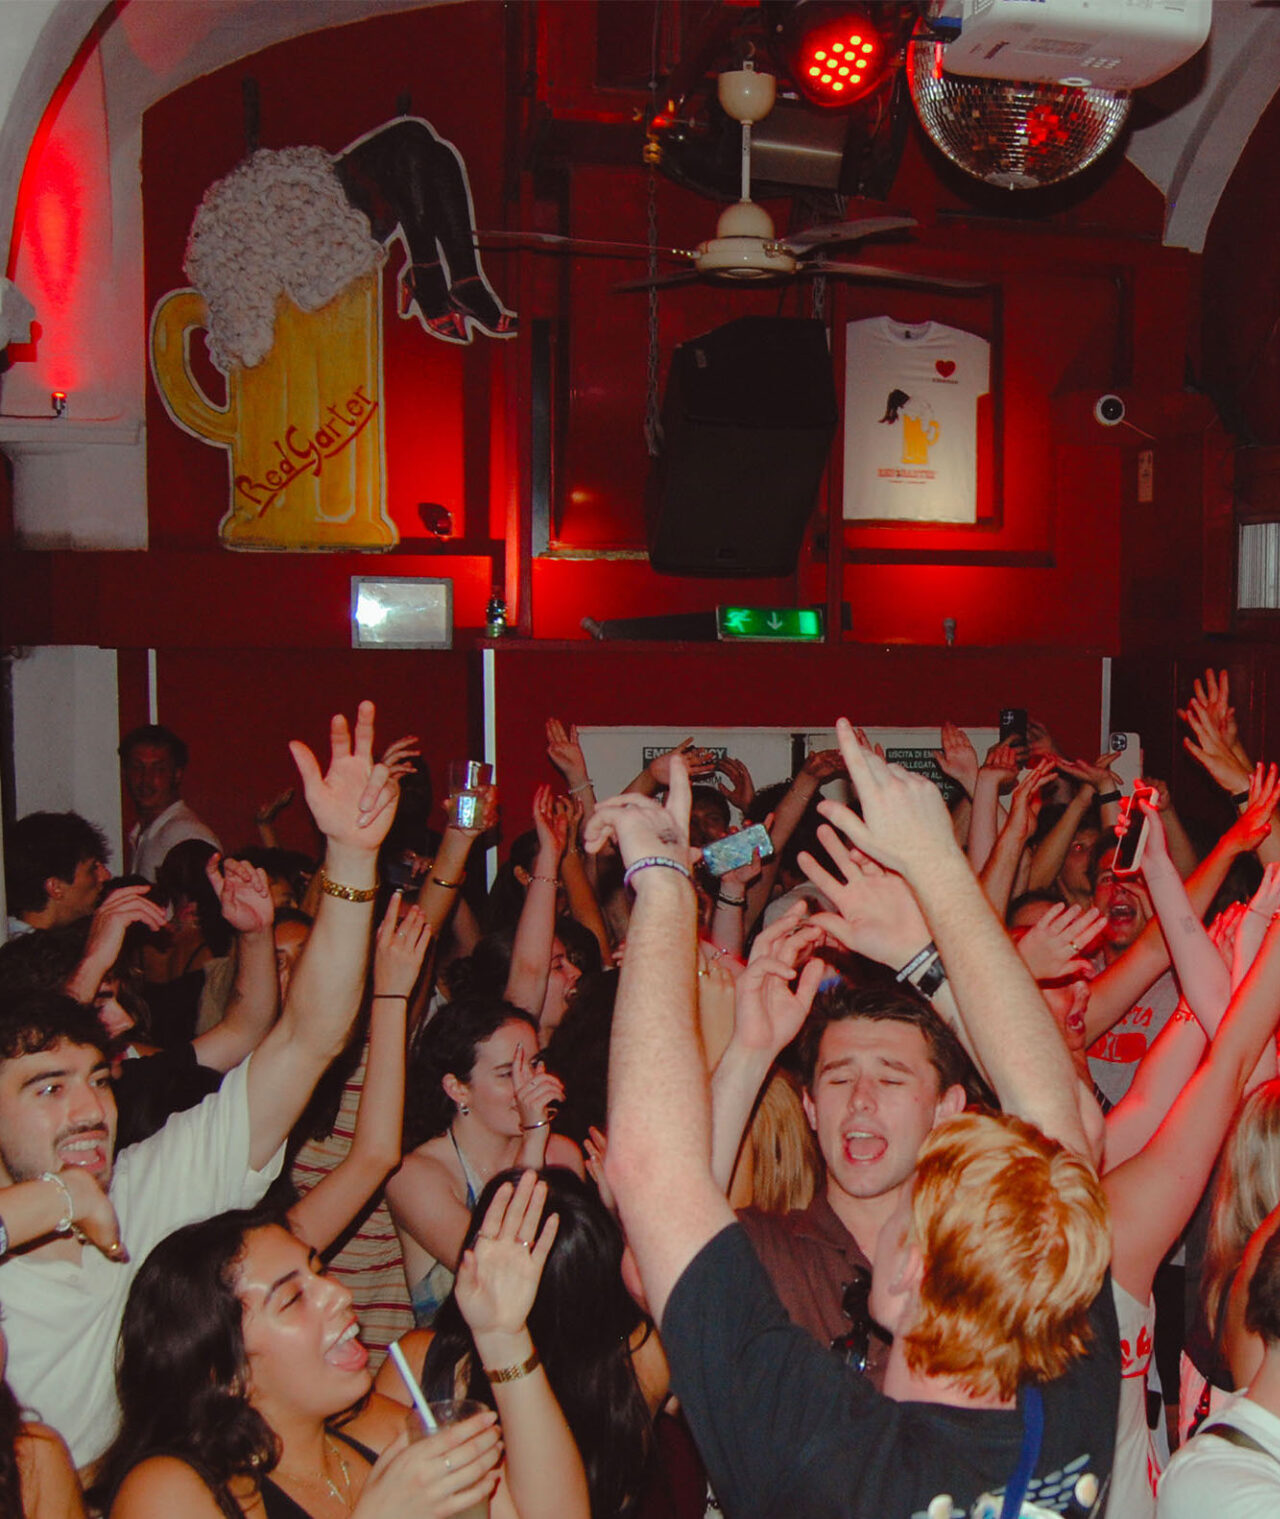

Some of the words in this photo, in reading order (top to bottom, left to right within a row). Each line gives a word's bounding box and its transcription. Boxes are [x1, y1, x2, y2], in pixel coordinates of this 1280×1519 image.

[234, 440, 296, 505] Red
[285, 384, 373, 477] Garter
[888, 750, 914, 759] USCITA
